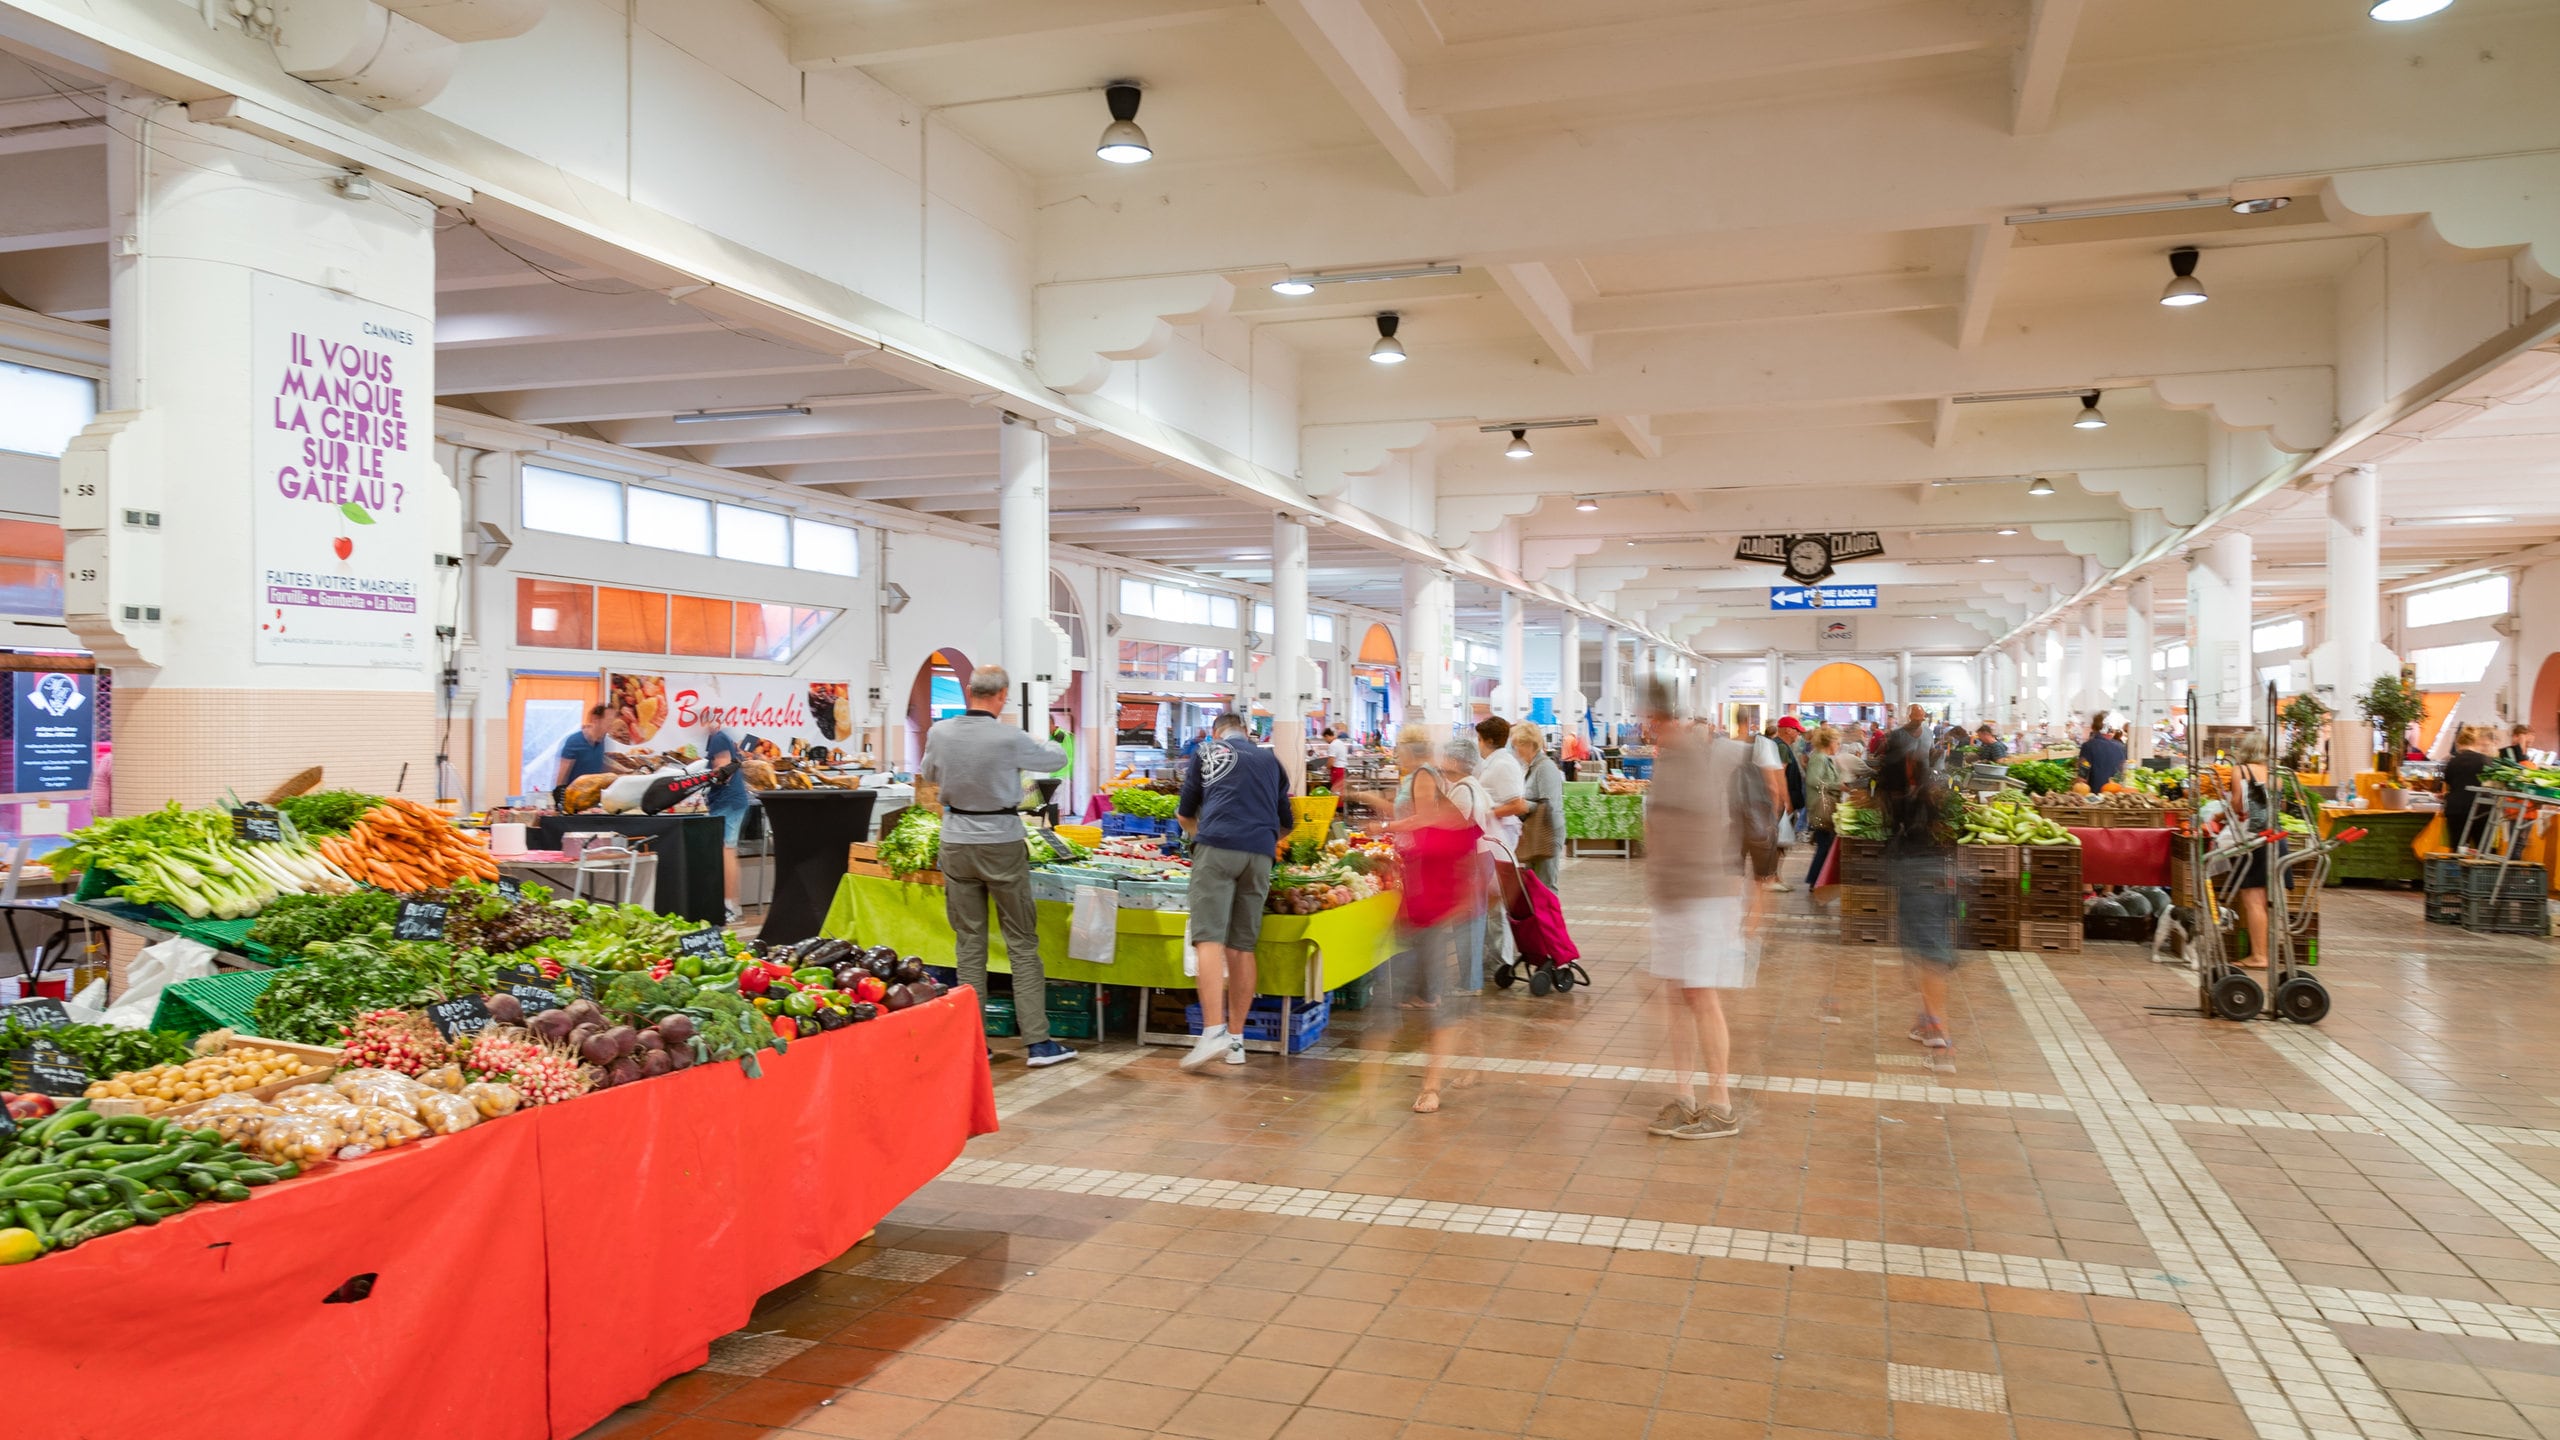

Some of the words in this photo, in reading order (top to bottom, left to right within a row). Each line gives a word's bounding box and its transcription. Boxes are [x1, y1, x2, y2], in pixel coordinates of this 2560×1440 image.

[362, 321, 414, 345] CANNES
[291, 332, 313, 368] IL
[318, 338, 393, 384] VOUS
[280, 367, 404, 419] MANQUE
[274, 396, 311, 434] LA
[321, 406, 408, 451] CERISE
[303, 436, 350, 474] SUR
[359, 445, 383, 479] LE
[77, 484, 95, 496] 58
[278, 465, 384, 511] GÂTEAU
[1740, 538, 1786, 556] CLAUDEL
[1831, 534, 1879, 555] CLAUDEL
[80, 569, 97, 581] 59
[266, 570, 312, 587] FAITES
[315, 573, 356, 591] VOTRE
[360, 577, 410, 595] MARCHÉ
[271, 587, 309, 605] Forville
[319, 591, 366, 609] Gambetta
[374, 596, 387, 609] La
[1837, 588, 1877, 598] LOCALE
[1821, 631, 1854, 640] CANNES
[674, 690, 804, 730] Bazarbachi
